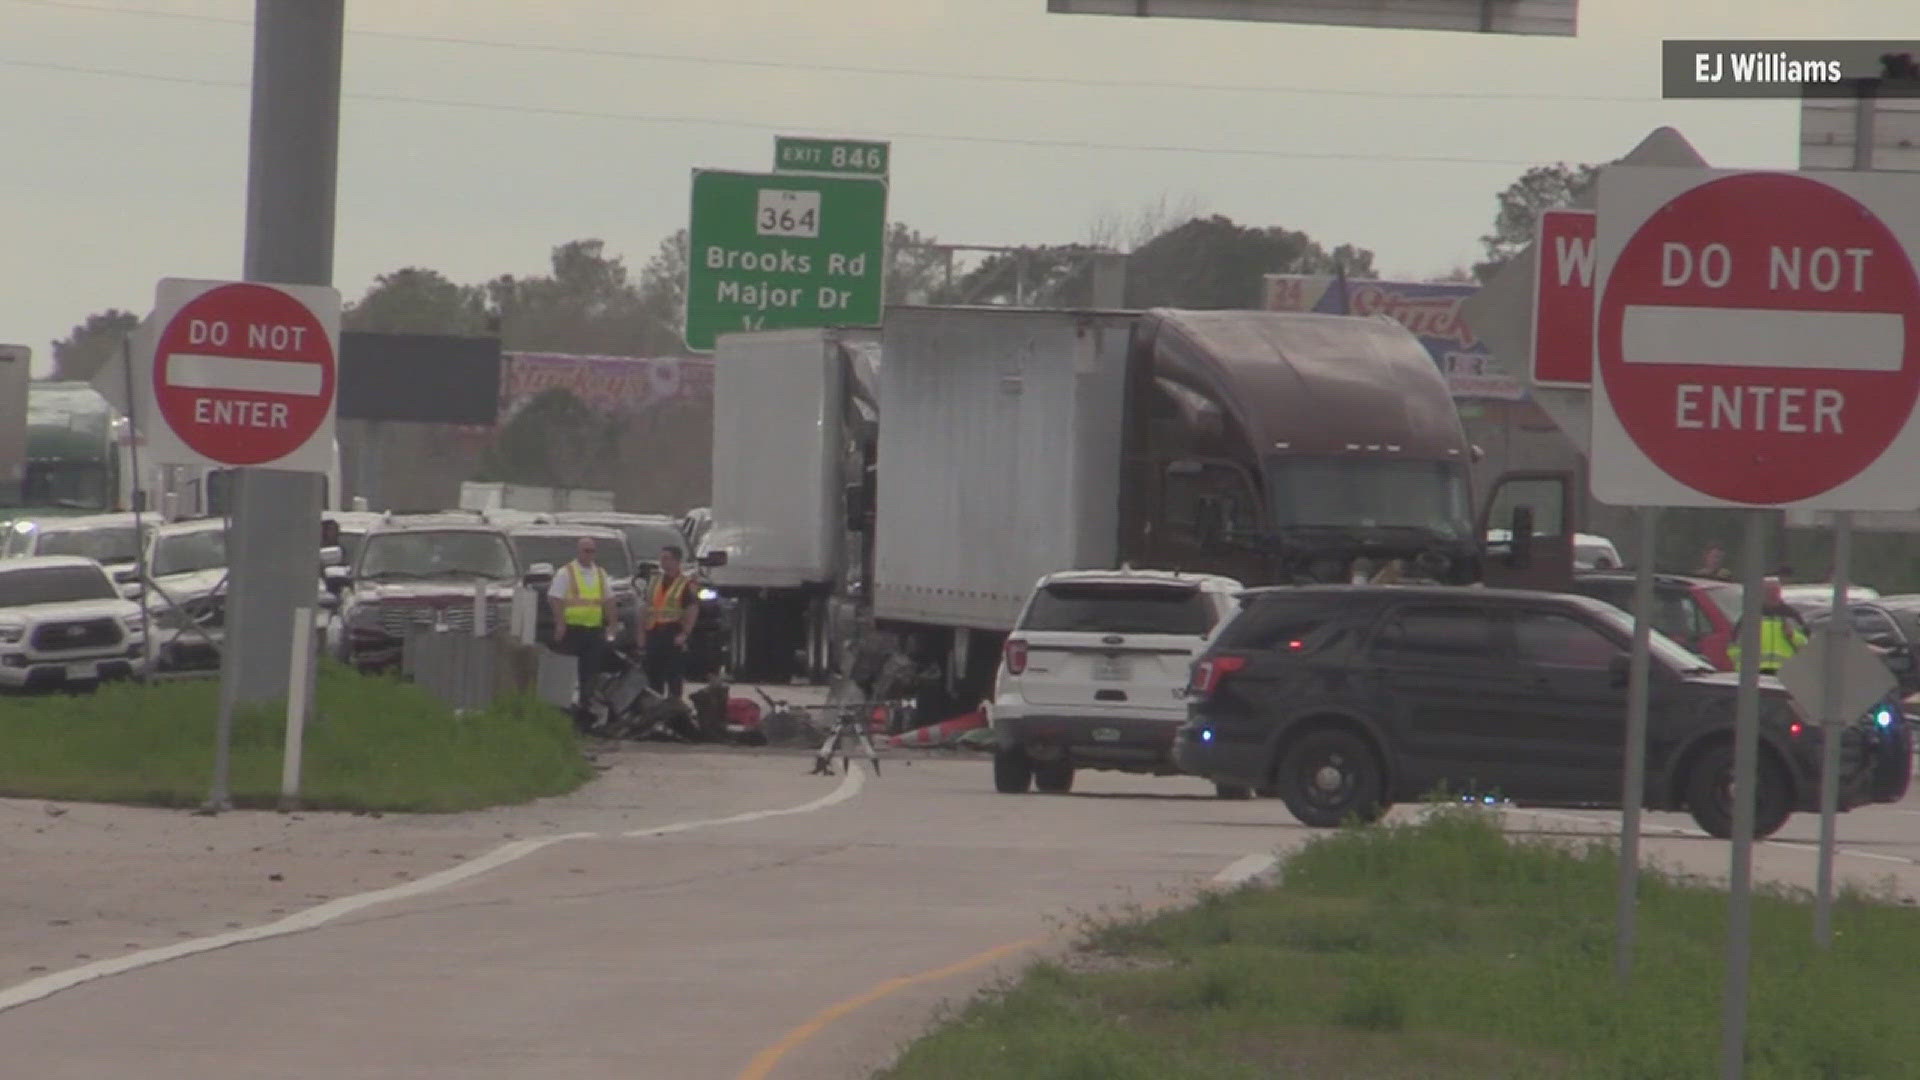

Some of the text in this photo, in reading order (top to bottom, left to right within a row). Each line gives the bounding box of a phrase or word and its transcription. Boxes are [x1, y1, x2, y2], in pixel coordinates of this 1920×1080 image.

[782, 146, 881, 168] EXIT 846
[760, 207, 815, 231] 364
[706, 247, 866, 277] Brooks Rd
[1556, 236, 1596, 288] W
[1661, 241, 1873, 292] DO NOT
[717, 281, 852, 311] Major Dr
[1353, 286, 1475, 347] Stuck
[189, 319, 307, 351] DO NOT
[195, 398, 288, 428] ENTER
[1676, 384, 1845, 435] ENTER
